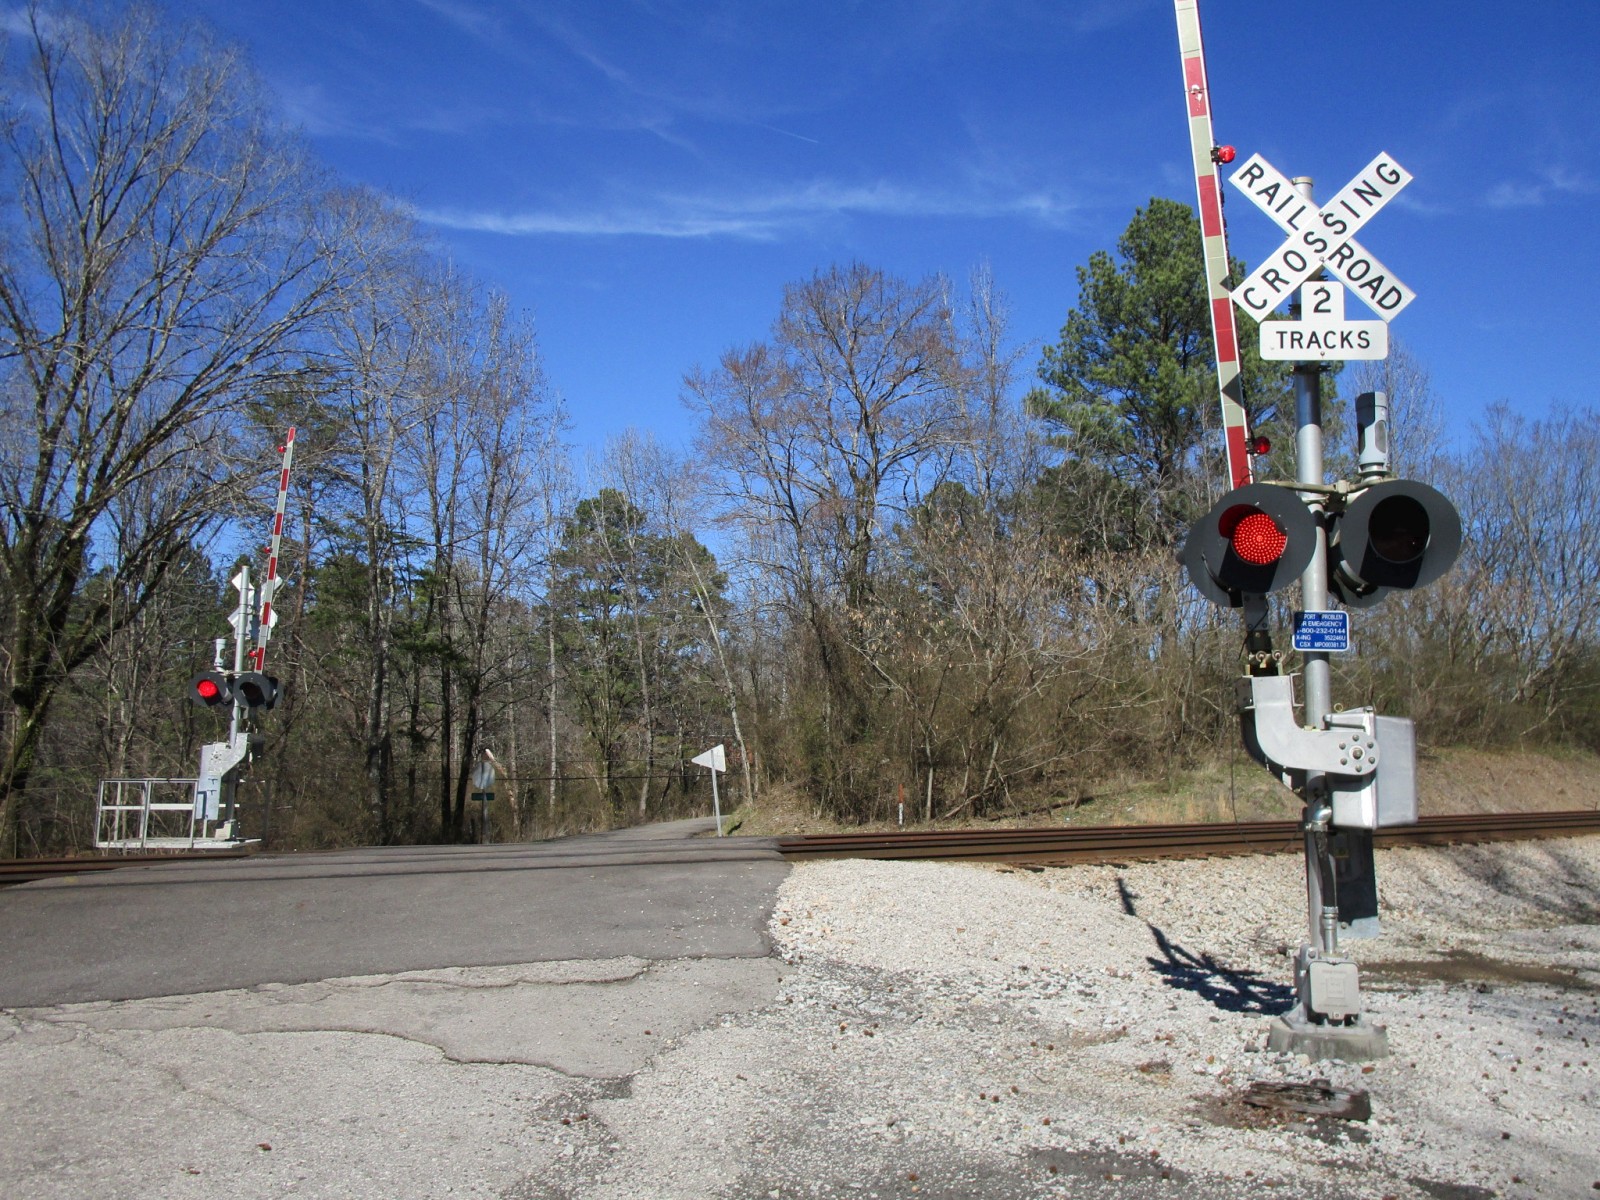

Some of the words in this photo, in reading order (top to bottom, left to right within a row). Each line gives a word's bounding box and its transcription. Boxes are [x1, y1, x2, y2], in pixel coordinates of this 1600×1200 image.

[1238, 162, 1307, 231] RAIL
[1328, 242, 1402, 310] ROAD
[1243, 162, 1401, 310] CROSSING
[1276, 331, 1370, 349] TRACKS
[1313, 288, 1332, 313] 2
